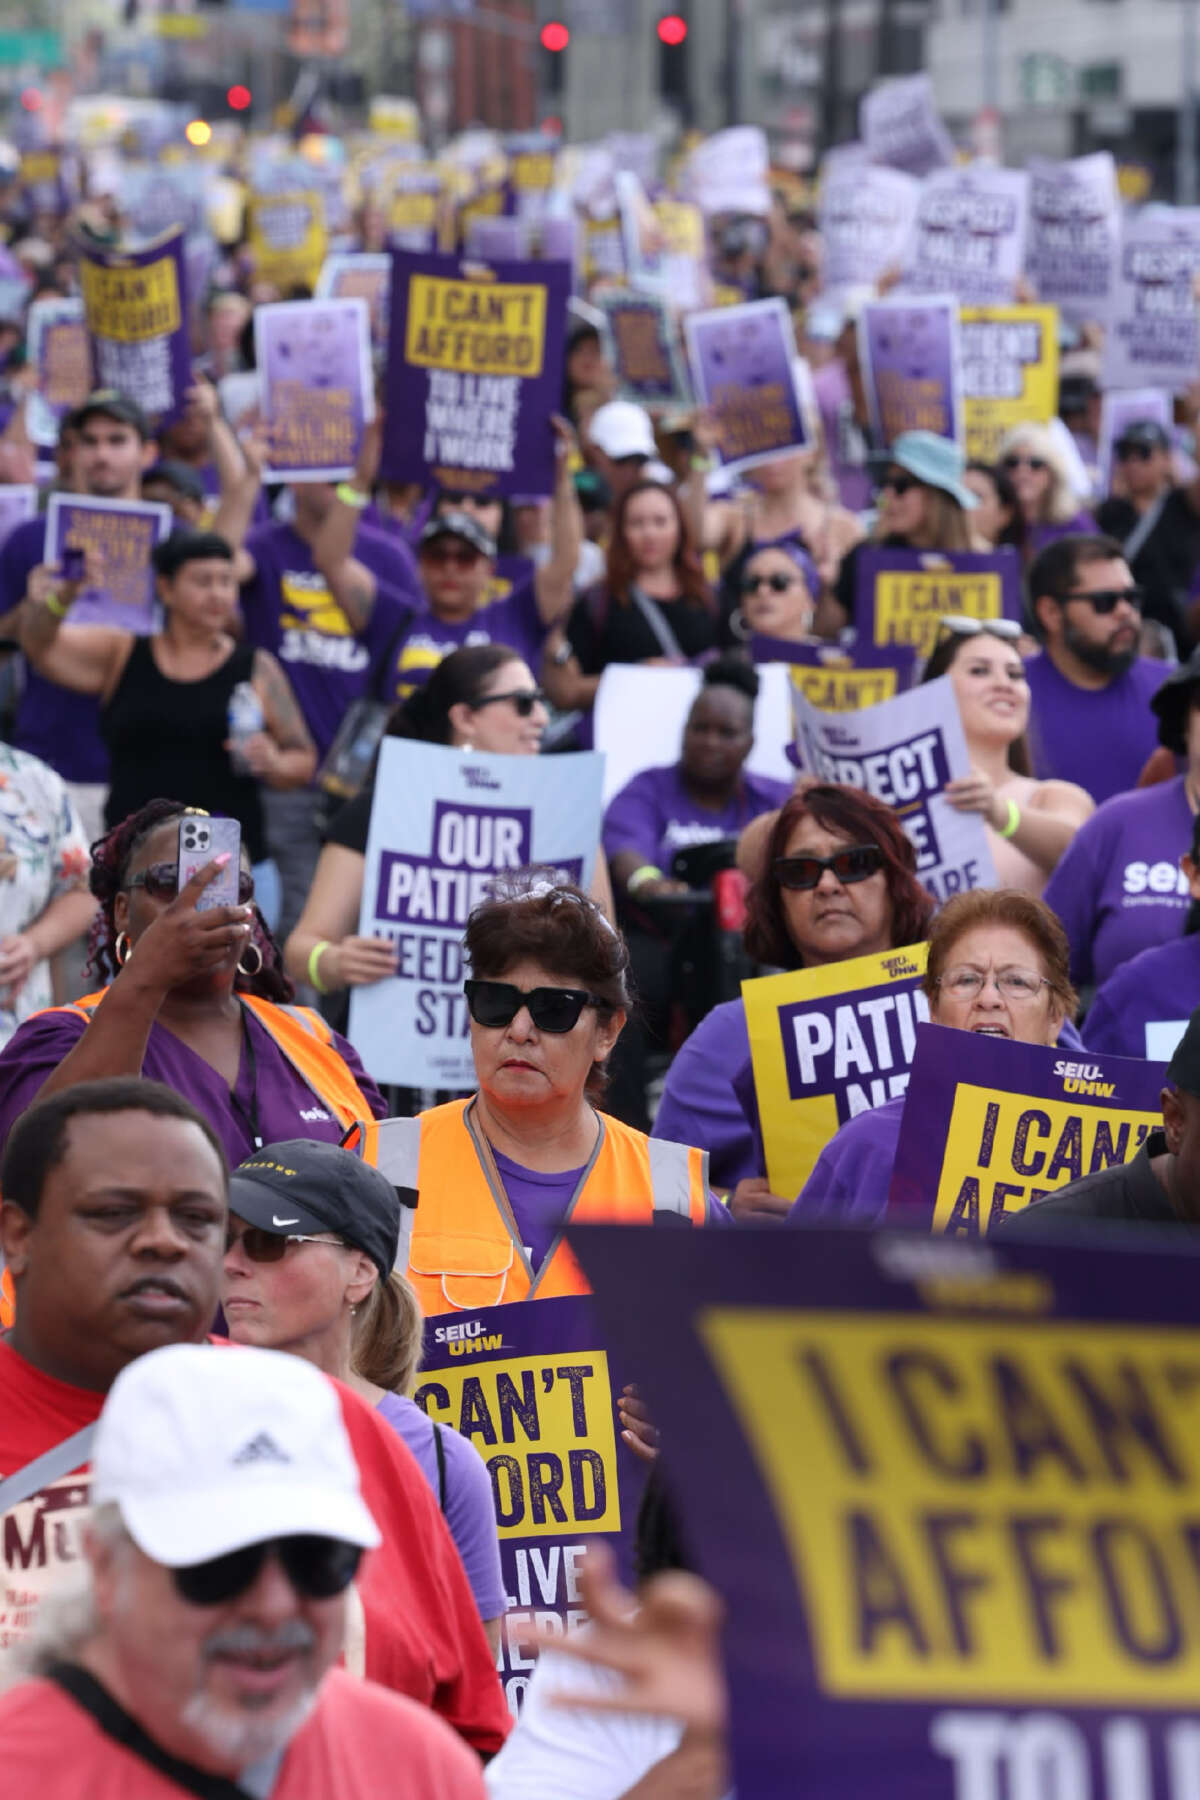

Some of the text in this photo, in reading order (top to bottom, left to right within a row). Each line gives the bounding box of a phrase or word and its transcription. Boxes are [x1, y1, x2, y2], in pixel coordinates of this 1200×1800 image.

[427, 286, 533, 327] I CAN'T
[416, 326, 533, 367] AFFORD
[910, 583, 989, 613] CAN'T
[437, 810, 524, 870] OUR
[374, 930, 464, 985] EED
[416, 989, 471, 1038] ST
[1053, 1060, 1105, 1081] SEIU-
[1063, 1077, 1117, 1099] UHW
[977, 1101, 1166, 1181] I CAN'
[435, 1321, 487, 1343] SEIU-
[449, 1334, 503, 1356] UHW
[413, 1364, 593, 1446] CAN'T
[798, 1343, 872, 1482] I
[486, 1448, 608, 1528] ORD
[930, 1709, 1092, 1800] TO
